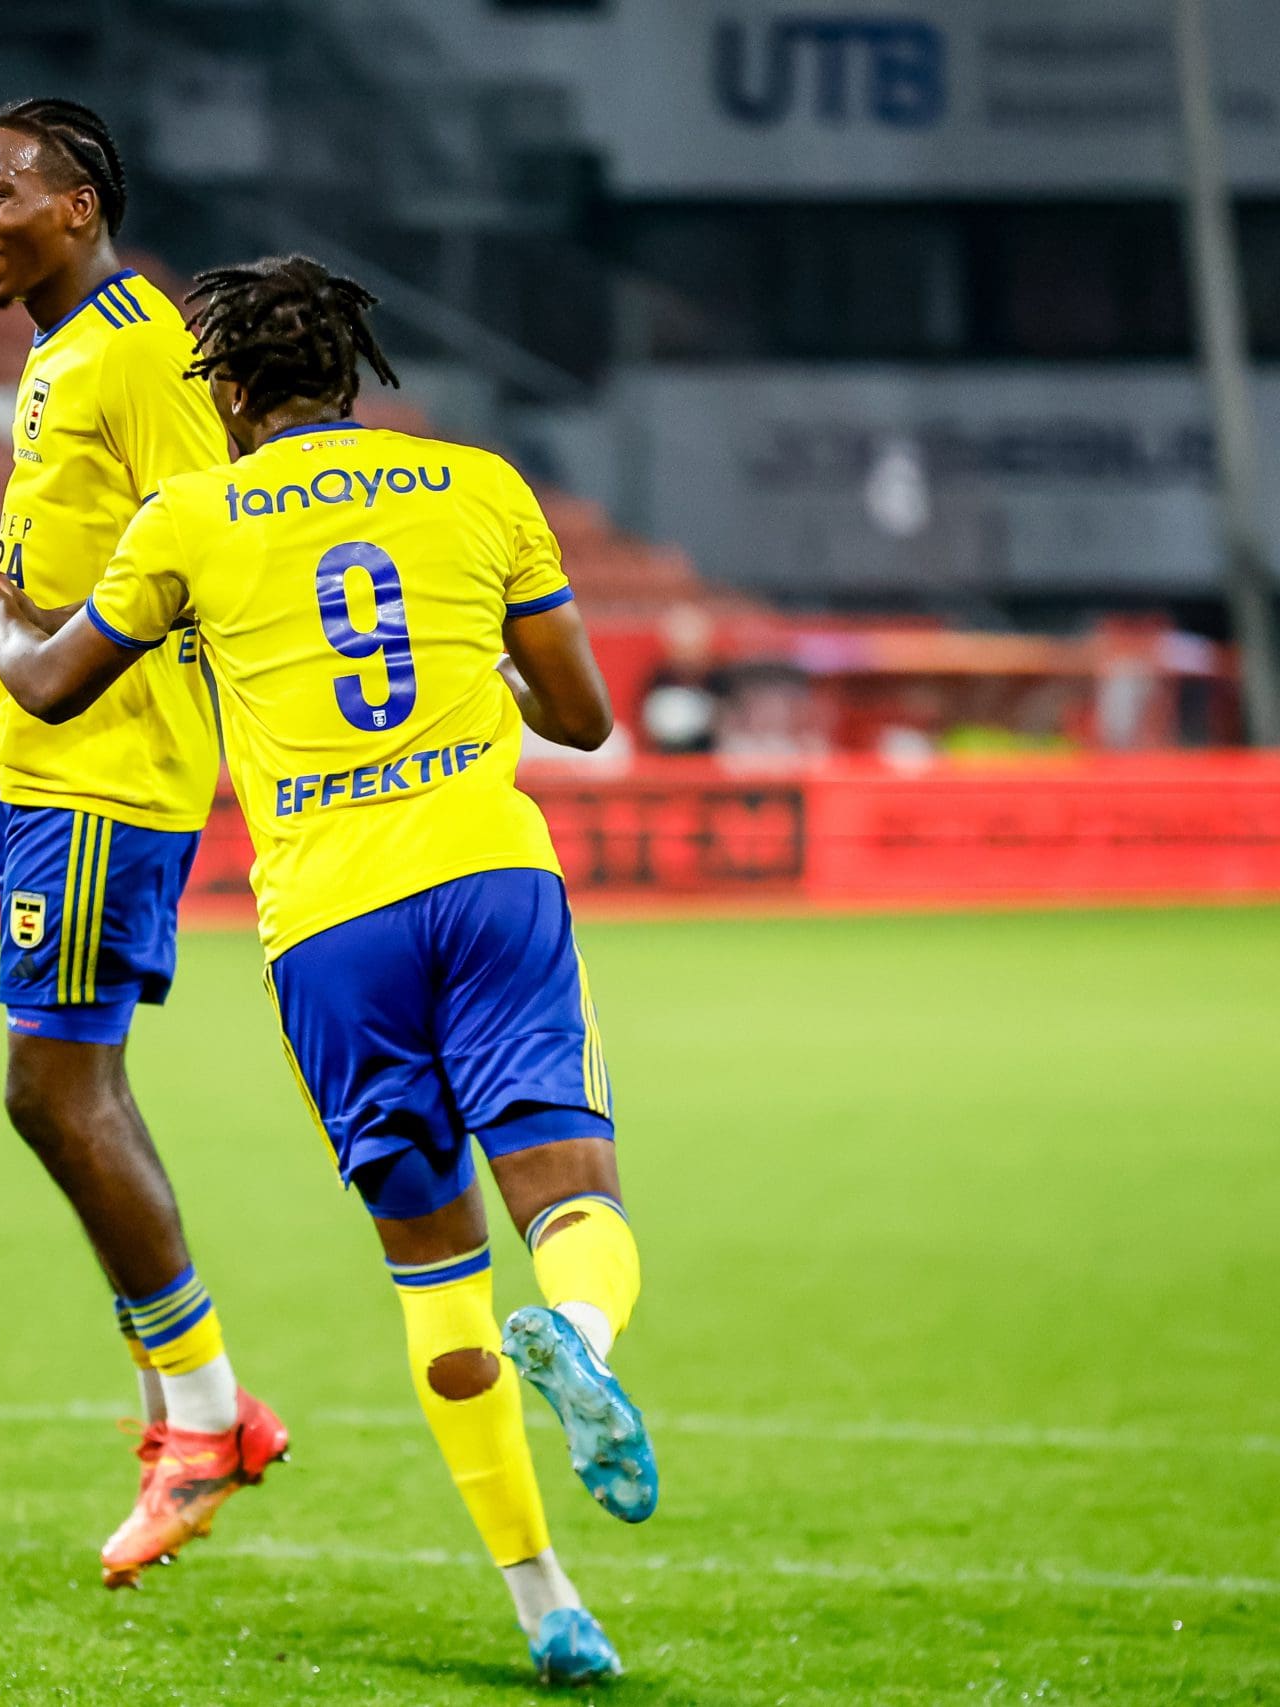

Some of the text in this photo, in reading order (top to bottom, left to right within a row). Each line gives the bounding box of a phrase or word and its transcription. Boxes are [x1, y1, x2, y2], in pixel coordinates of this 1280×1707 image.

[710, 16, 948, 132] UTB
[225, 466, 451, 522] tanQyou
[316, 541, 417, 732] 9
[276, 742, 493, 817] EFFEKTIE
